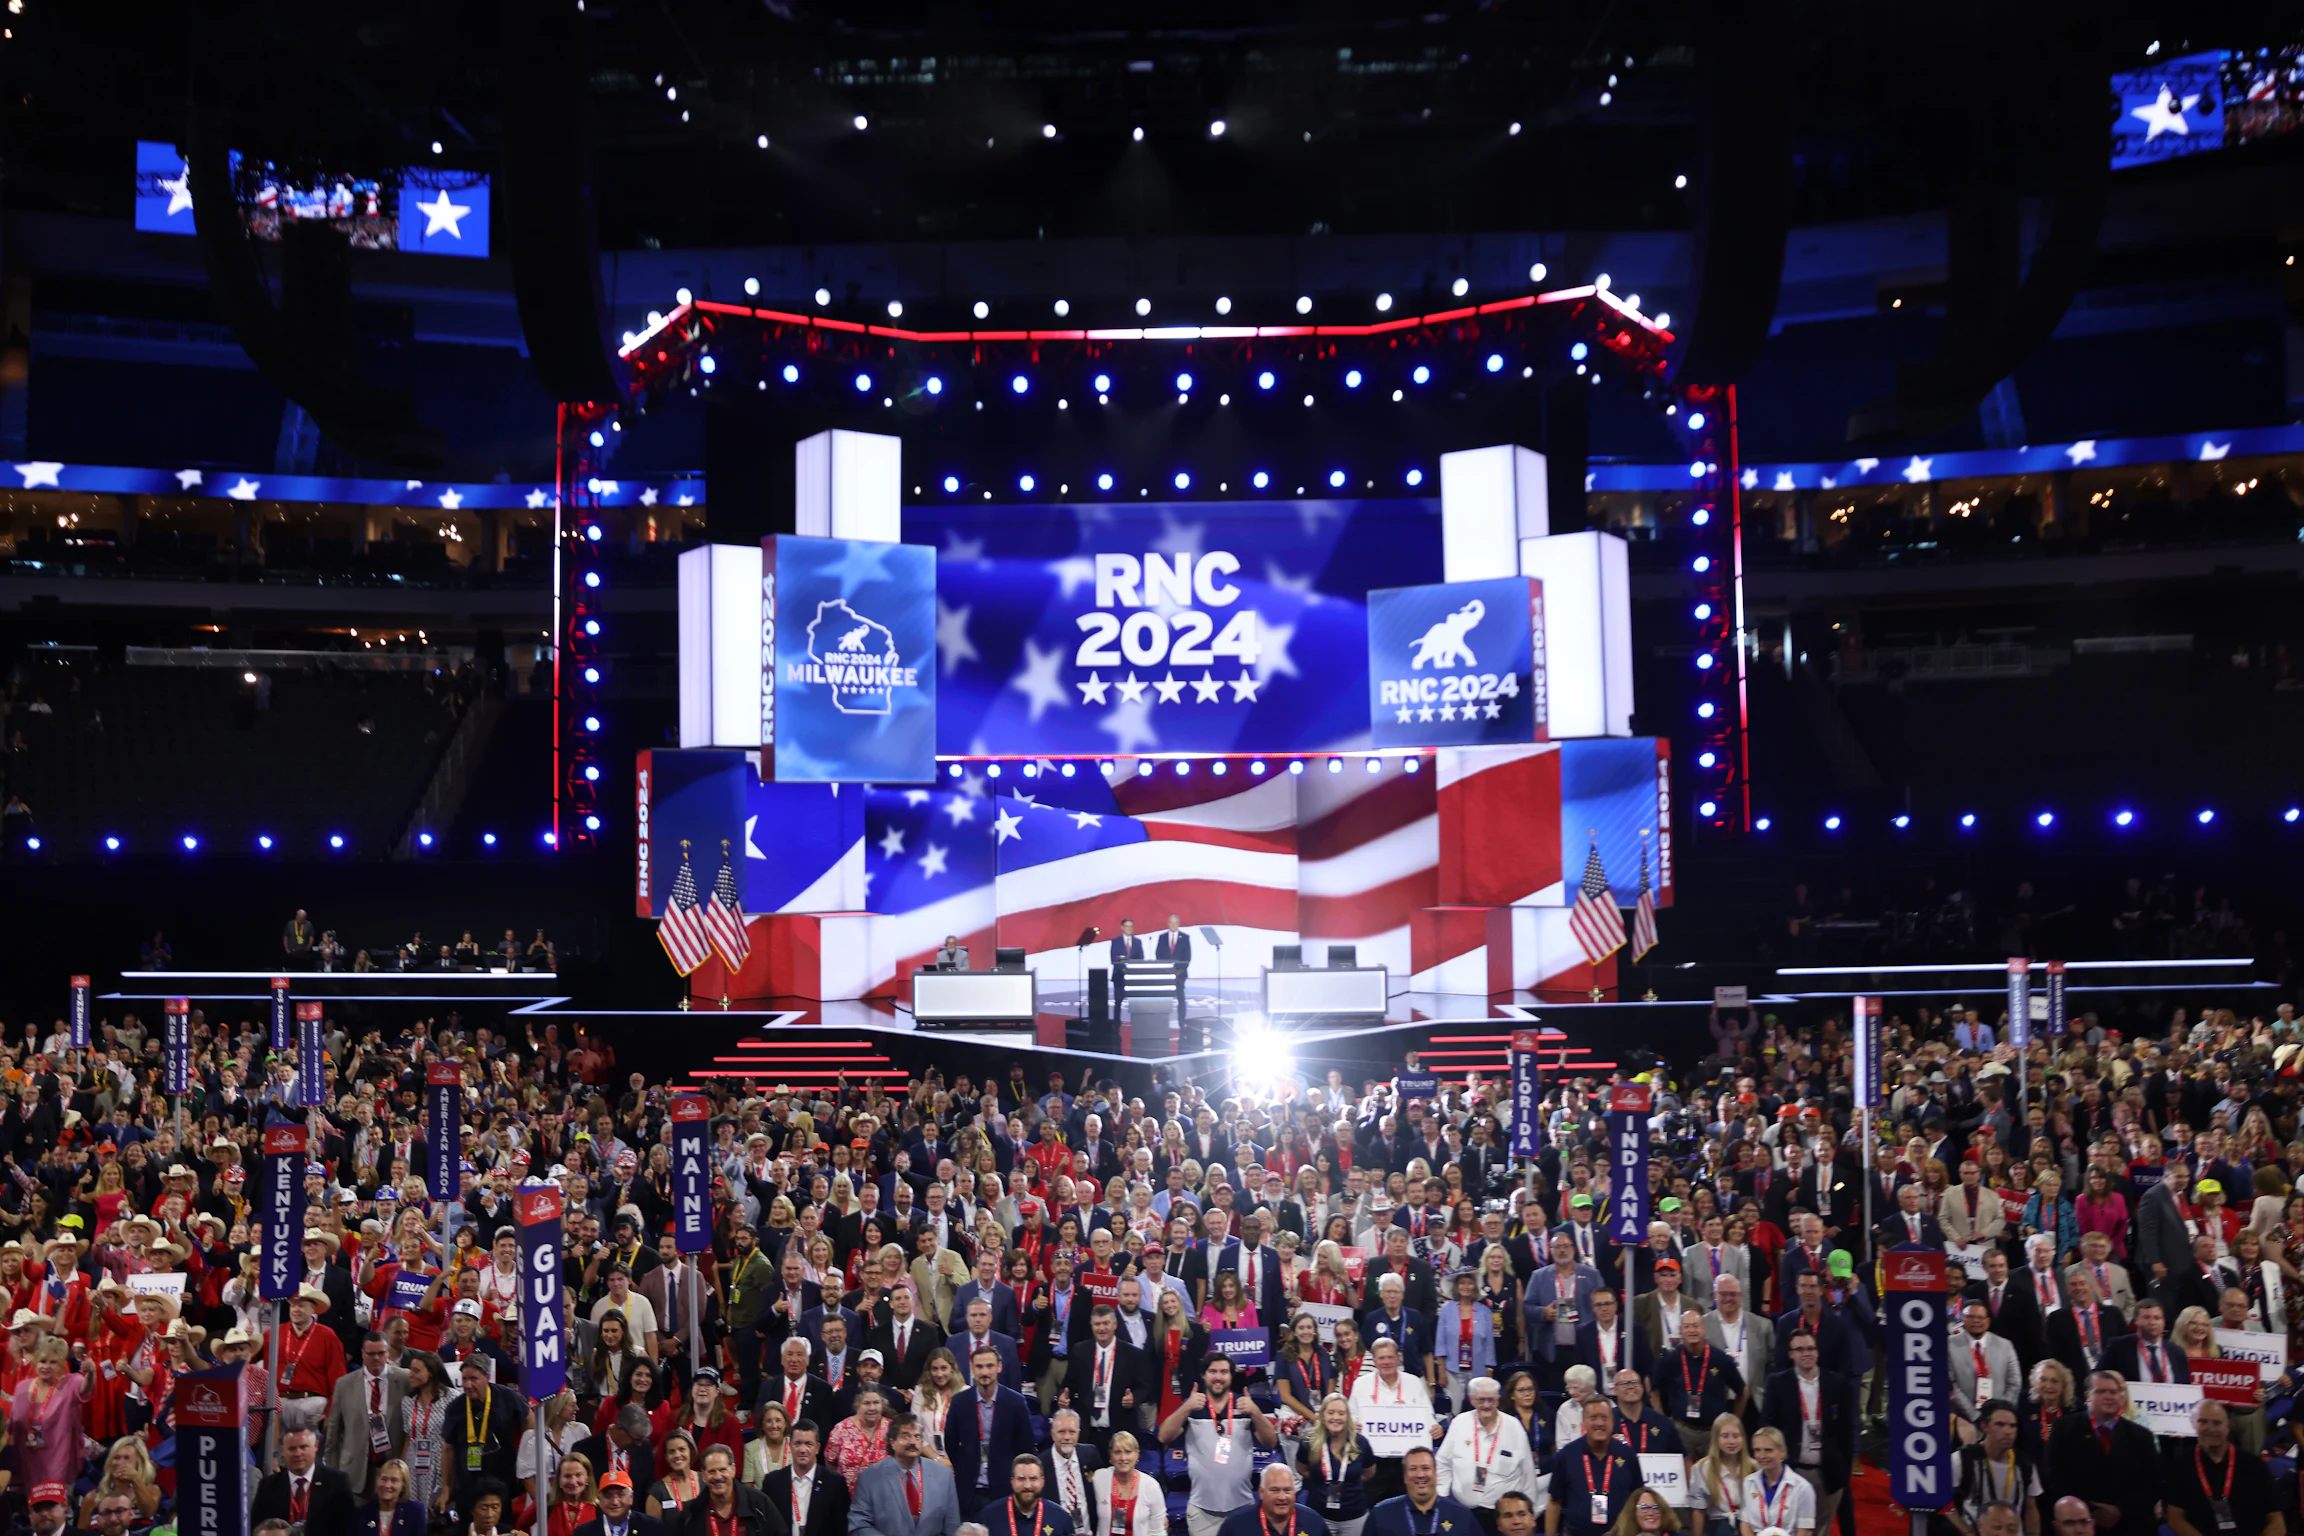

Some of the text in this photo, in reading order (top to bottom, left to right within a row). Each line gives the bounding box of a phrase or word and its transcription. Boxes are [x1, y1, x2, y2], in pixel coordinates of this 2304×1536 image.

[1095, 550, 1241, 607] RNC
[761, 572, 775, 744] RNC 2024
[825, 653, 881, 666] RNC 2024
[1075, 610, 1262, 667] 2024
[786, 664, 918, 687] MILWAUKEE
[1380, 671, 1520, 706] RNC 2024
[638, 769, 650, 898] RNC 2024
[2012, 973, 2022, 1043] WISCONSIN
[2054, 973, 2063, 1033] NEBRASKA
[168, 1014, 177, 1091] NEW YORK
[1400, 1080, 1436, 1088] TRUMP
[1518, 1053, 1533, 1150] FLORIDA
[440, 1087, 449, 1152] AMERICAN
[439, 1154, 449, 1195] SAMOA
[681, 1136, 701, 1233] MAINE
[1620, 1115, 1639, 1236] INDIANA
[272, 1156, 293, 1290] KENTUCKY
[395, 1281, 430, 1293] TRUM
[533, 1243, 560, 1369] GUAM
[1215, 1340, 1266, 1352] TRUMP
[1900, 1299, 1938, 1494] OREGON
[2191, 1371, 2255, 1386] TRUMP
[186, 1405, 228, 1414] MILWAUKEE
[1365, 1421, 1425, 1433] TRUMP
[198, 1435, 218, 1536] PUER
